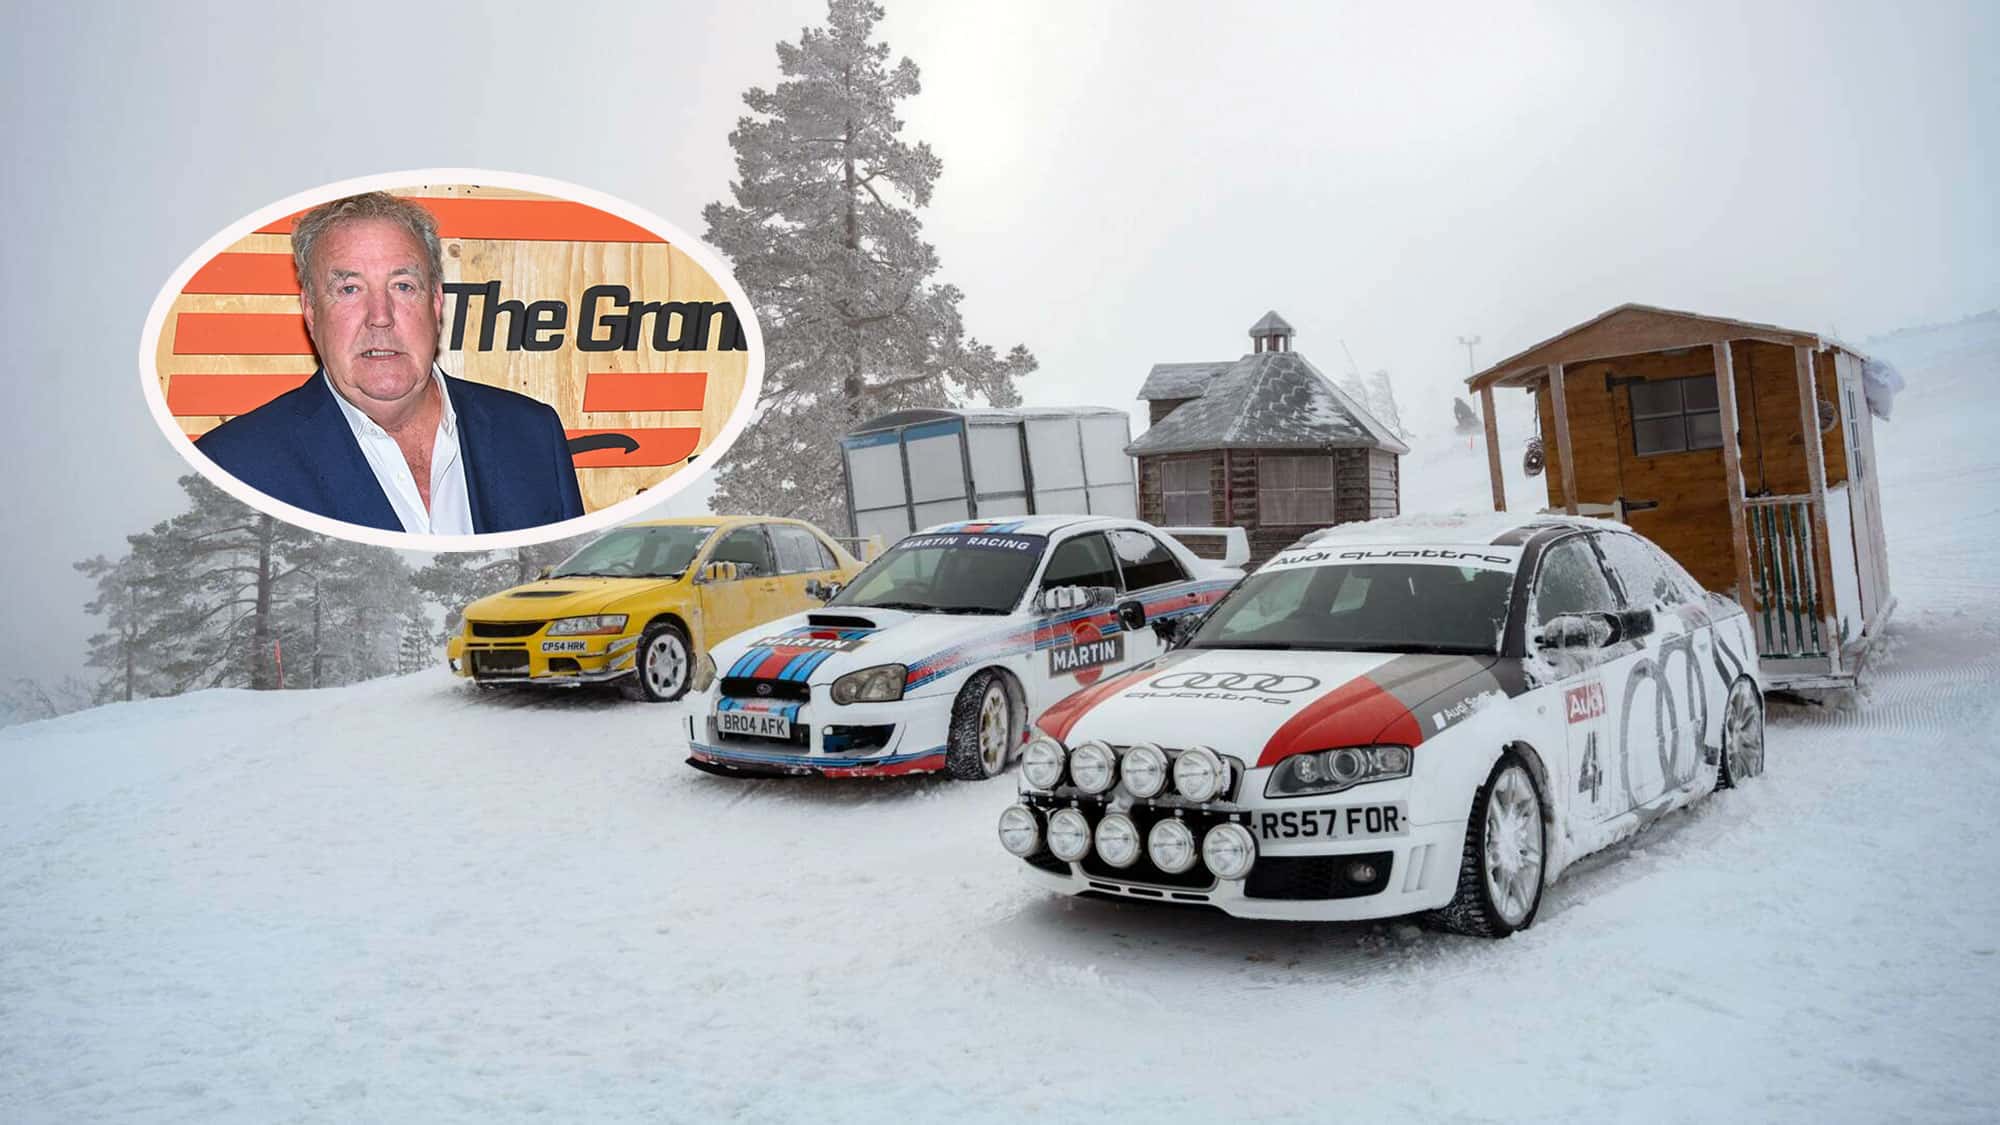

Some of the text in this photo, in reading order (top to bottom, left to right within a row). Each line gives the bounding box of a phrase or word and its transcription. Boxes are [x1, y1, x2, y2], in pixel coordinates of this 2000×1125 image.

[444, 281, 568, 351] The
[901, 536, 1030, 550] MARTIN RACING
[1274, 549, 1512, 566] Audi quattro
[567, 642, 585, 650] HRK
[757, 637, 849, 650] MARTIN
[1053, 640, 1117, 671] MARTIN
[1125, 692, 1291, 704] quattro
[724, 715, 785, 736] BR04 AFK
[1261, 805, 1399, 840] RS57 FOR
